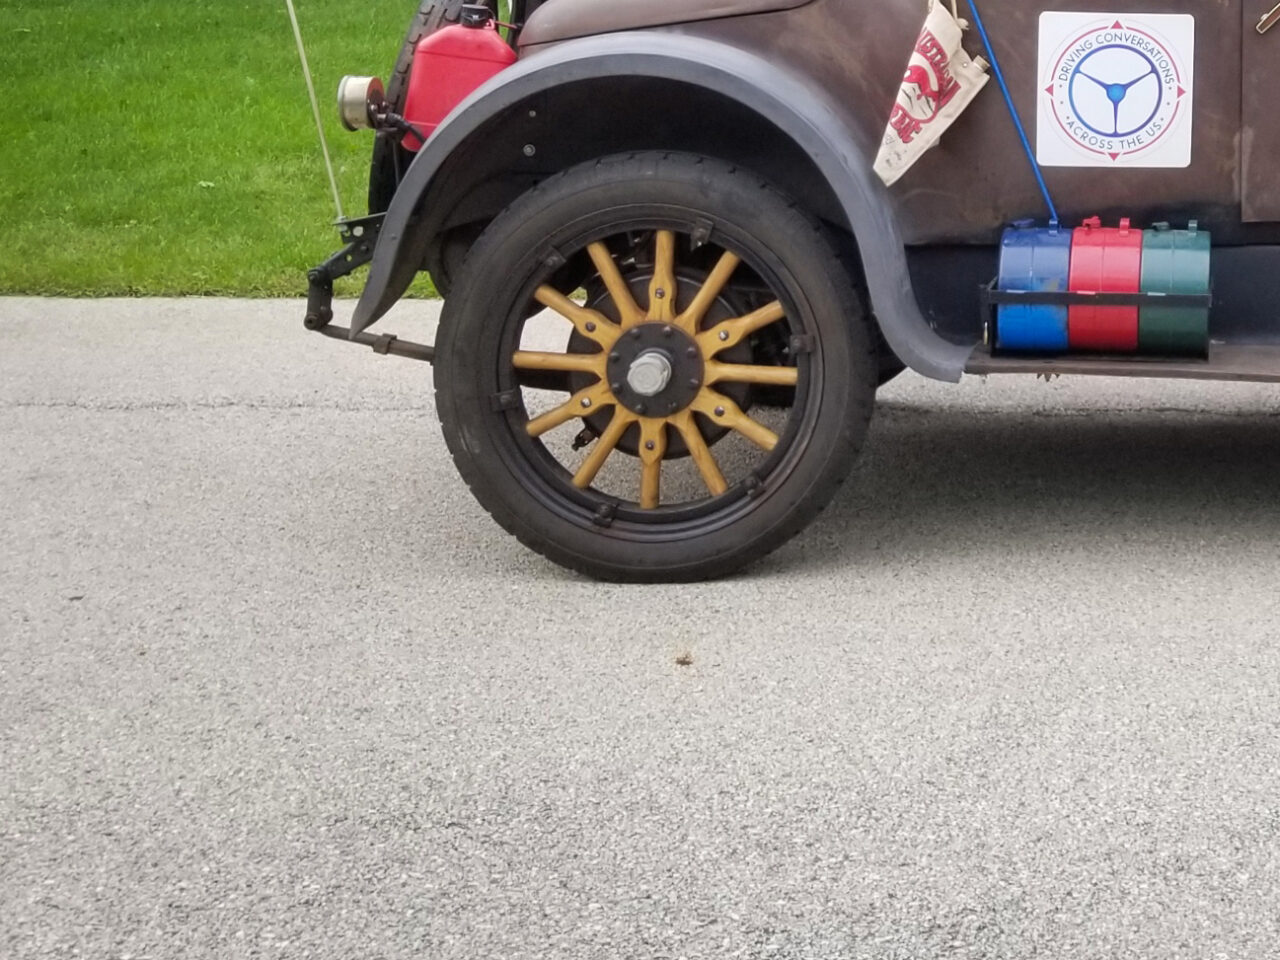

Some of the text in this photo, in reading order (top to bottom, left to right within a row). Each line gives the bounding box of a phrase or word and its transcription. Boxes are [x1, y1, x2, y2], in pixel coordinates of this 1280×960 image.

[1058, 32, 1175, 85] DRIVING CONVERSATIONS
[1067, 120, 1162, 150] ACROSS THE US
